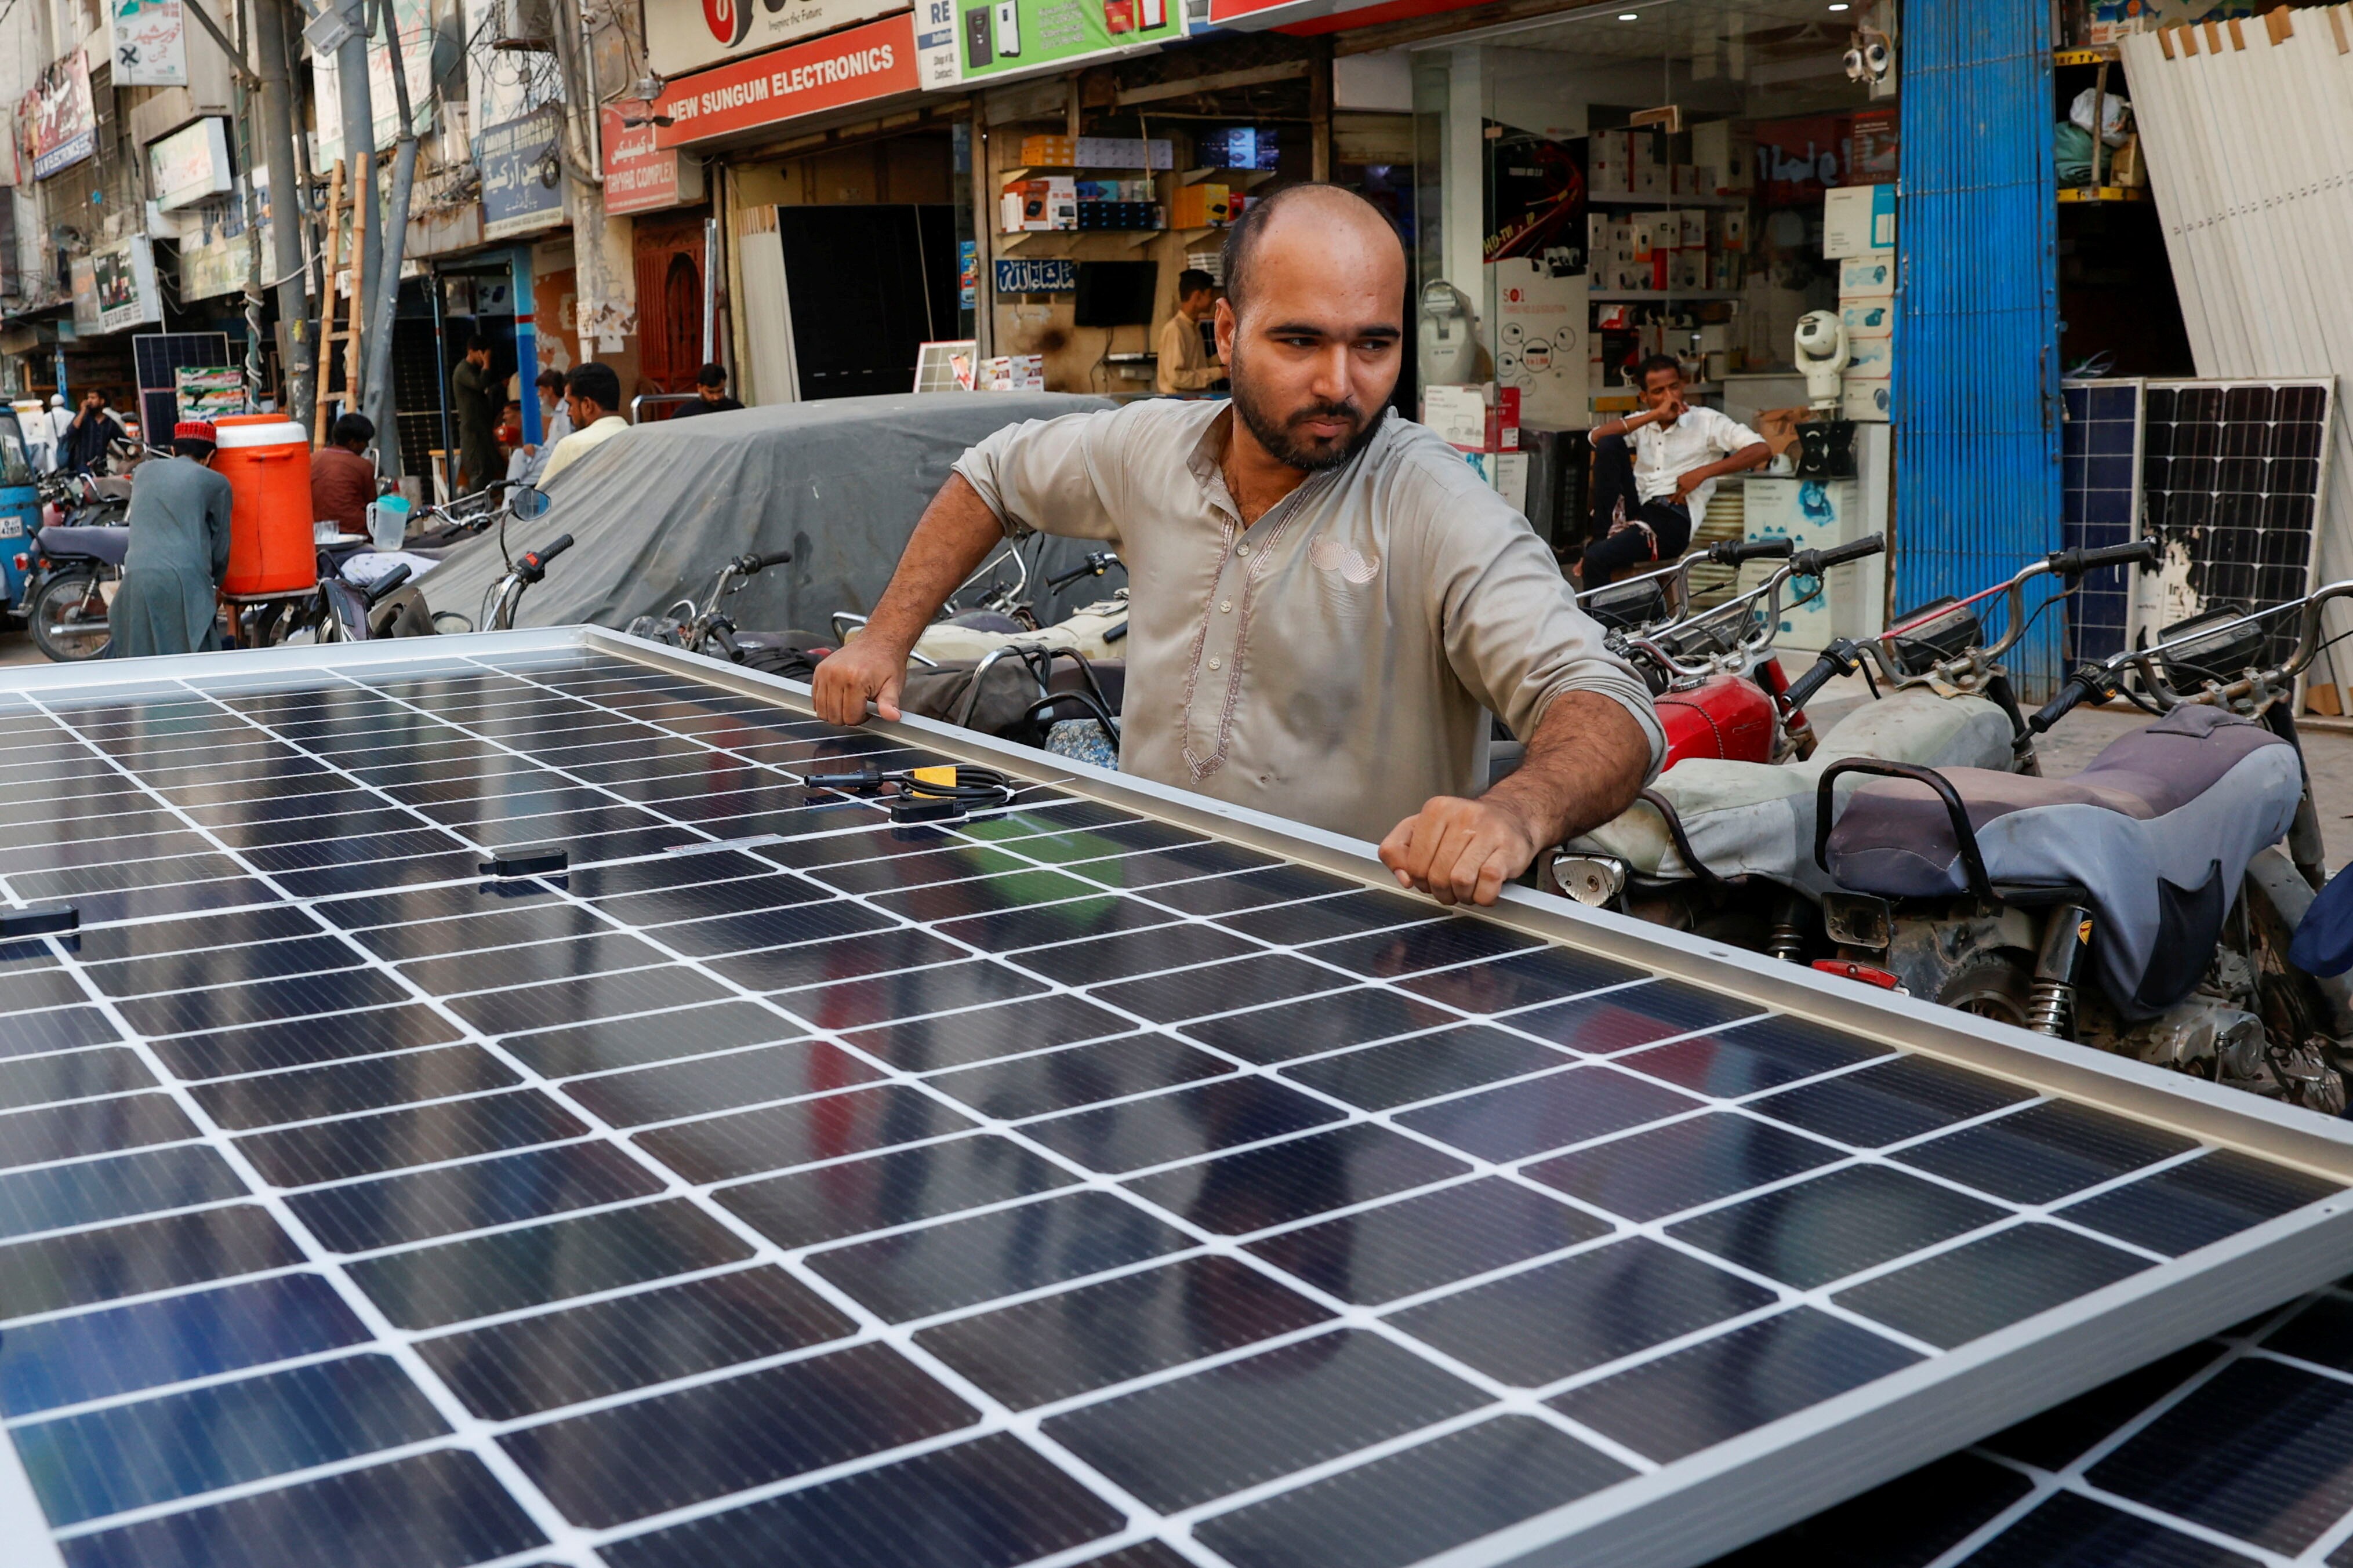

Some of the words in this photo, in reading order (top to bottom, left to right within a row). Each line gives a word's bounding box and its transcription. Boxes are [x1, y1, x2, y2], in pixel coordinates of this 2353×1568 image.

[768, 17, 789, 32] Inspire
[790, 13, 800, 24] the
[801, 7, 823, 23] Future
[667, 96, 699, 123] NEW
[702, 77, 769, 115] SUNGUM
[772, 44, 895, 97] ELECTRONICS
